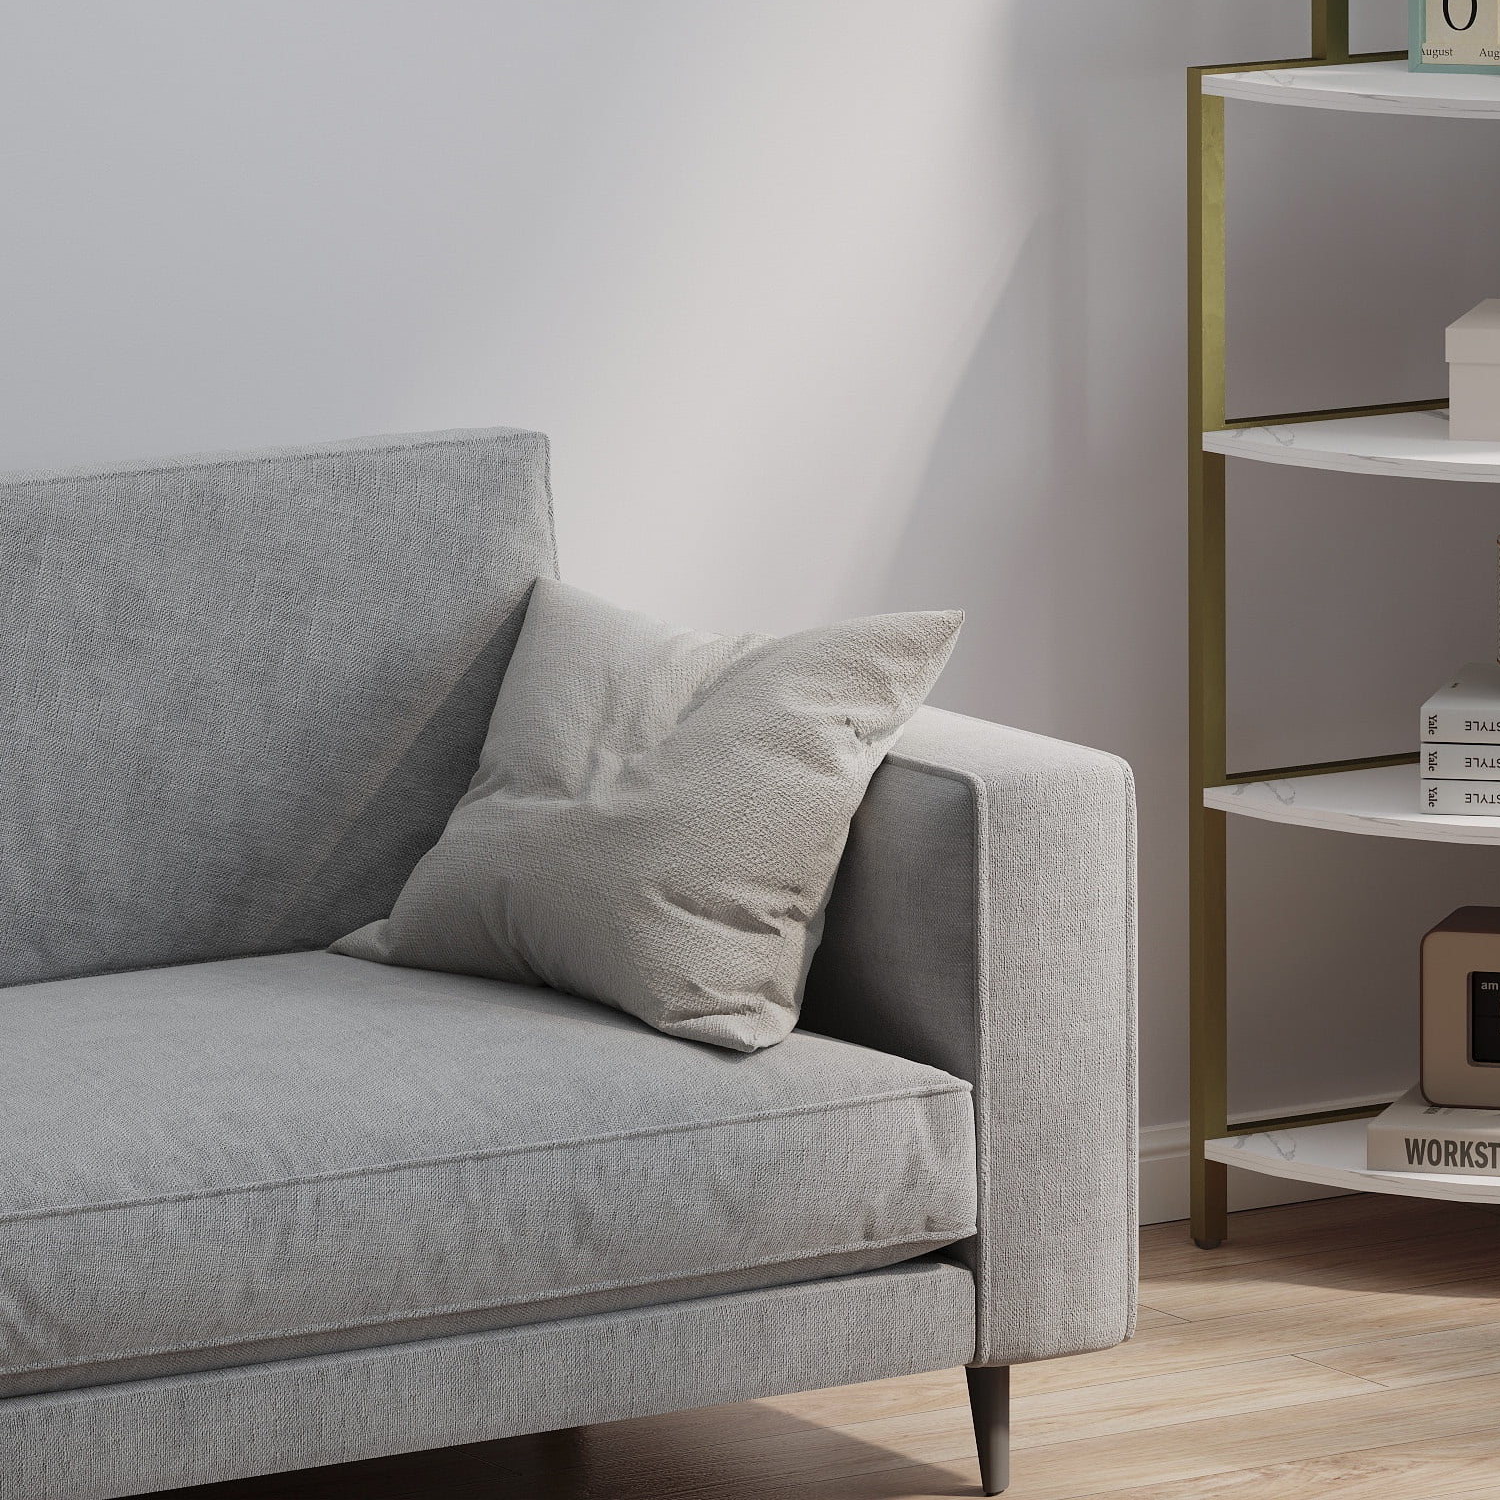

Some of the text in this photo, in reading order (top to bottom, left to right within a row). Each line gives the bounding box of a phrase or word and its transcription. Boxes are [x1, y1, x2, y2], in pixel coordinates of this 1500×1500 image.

[1428, 714, 1438, 736] Yale
[1428, 750, 1438, 772] Yale
[1428, 786, 1438, 808] Yale
[1480, 982, 1499, 991] am
